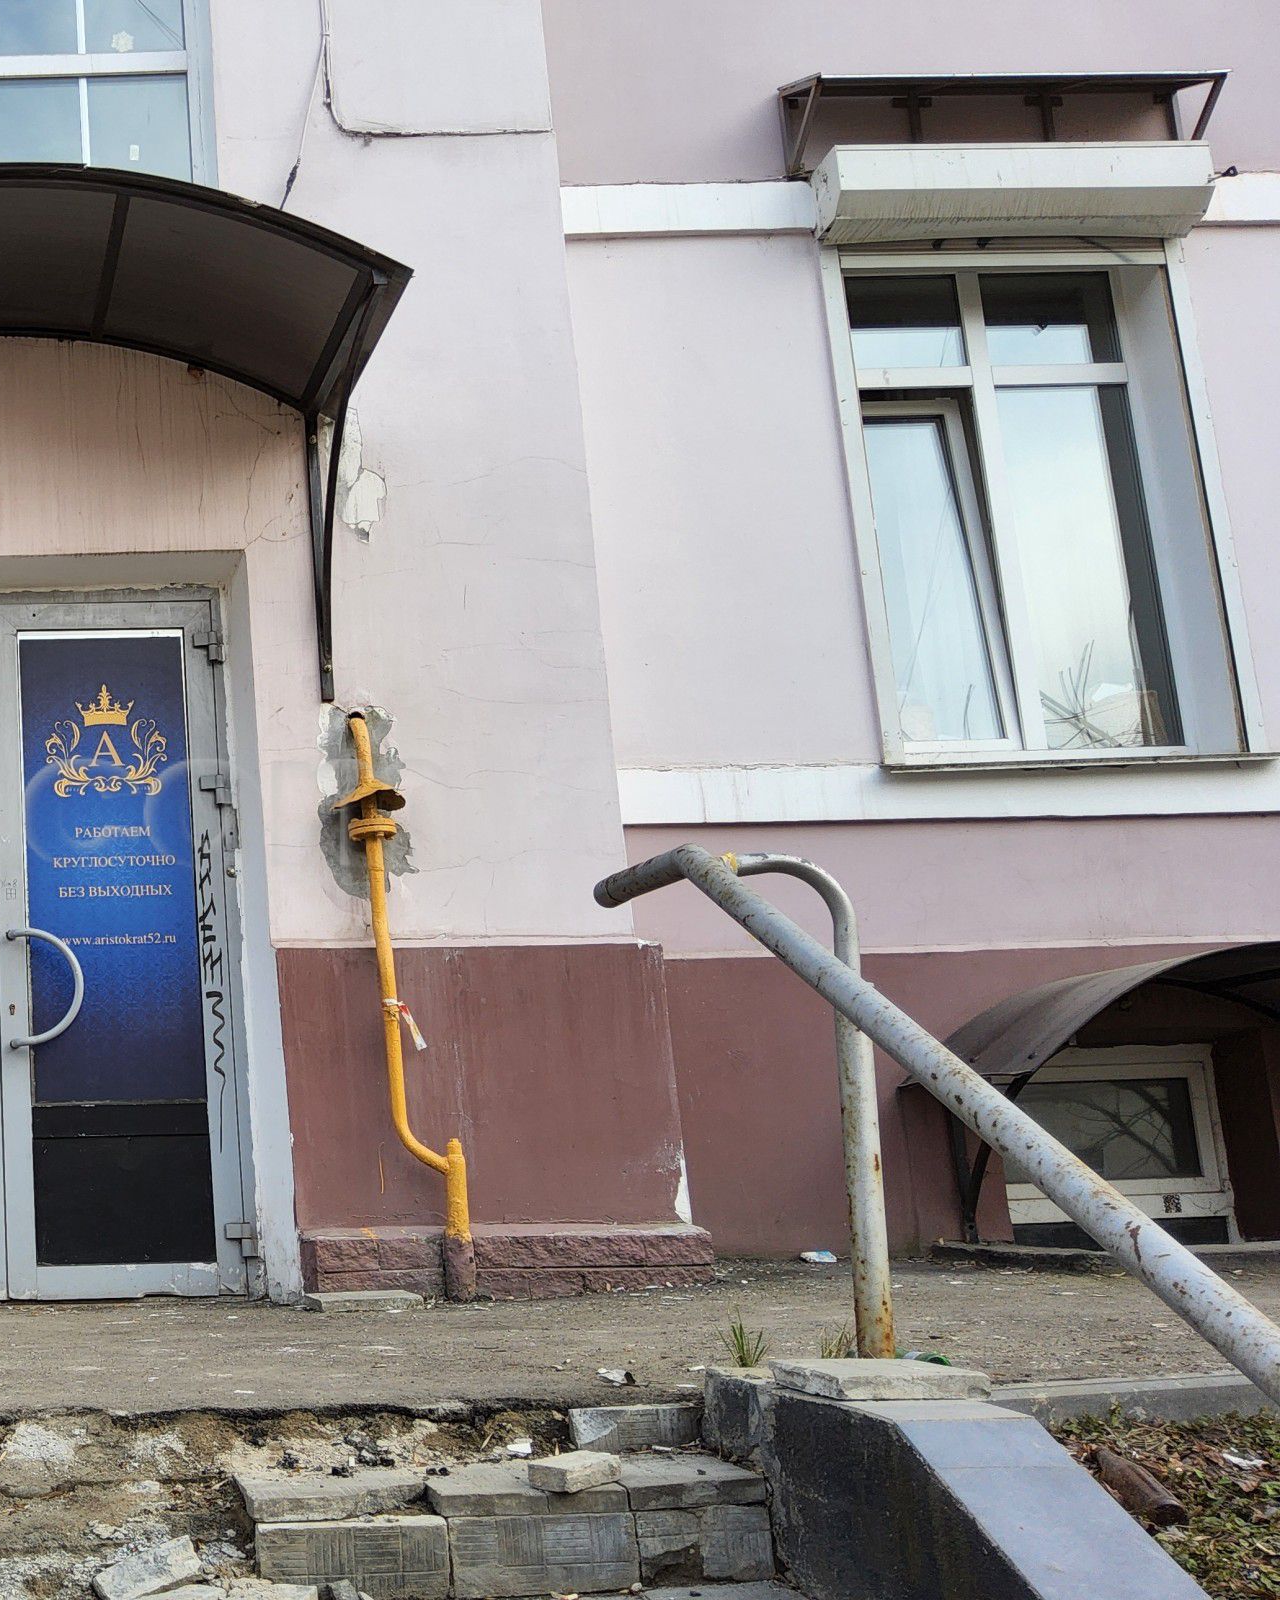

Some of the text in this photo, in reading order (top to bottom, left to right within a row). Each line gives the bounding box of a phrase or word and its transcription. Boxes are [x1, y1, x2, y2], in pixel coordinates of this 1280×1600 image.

[74, 826, 151, 839] РАБОТАЕМ
[53, 854, 177, 869] КРУГЛОСУТОЧНО
[59, 884, 173, 898] БЕЗ ВЫХОДНЫХ
